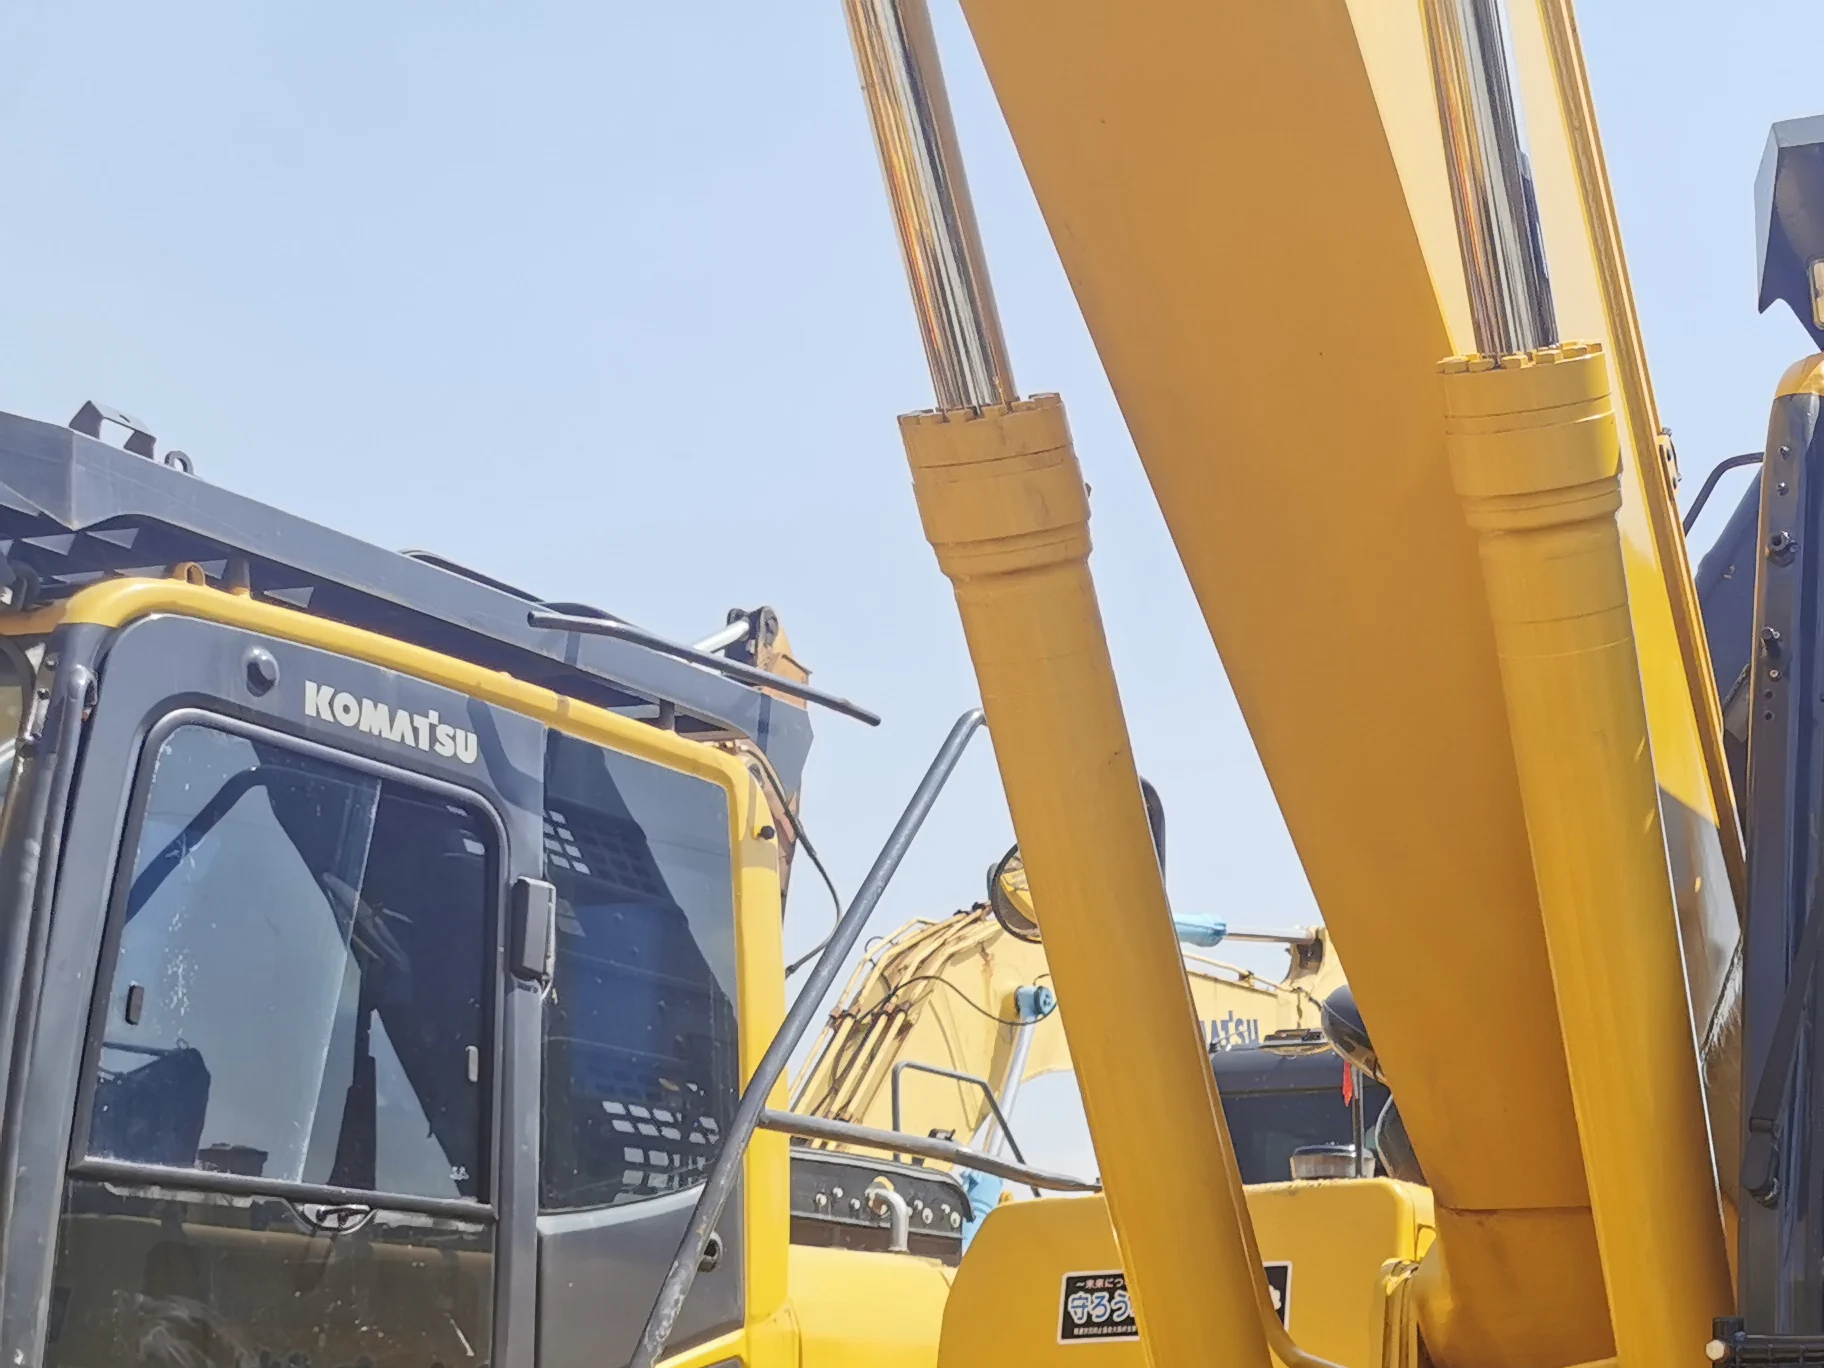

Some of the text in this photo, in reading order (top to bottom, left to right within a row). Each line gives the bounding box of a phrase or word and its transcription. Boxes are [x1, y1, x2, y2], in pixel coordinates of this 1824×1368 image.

[305, 680, 478, 764] KOMATSU
[1068, 1290, 1135, 1324] 守ろう
